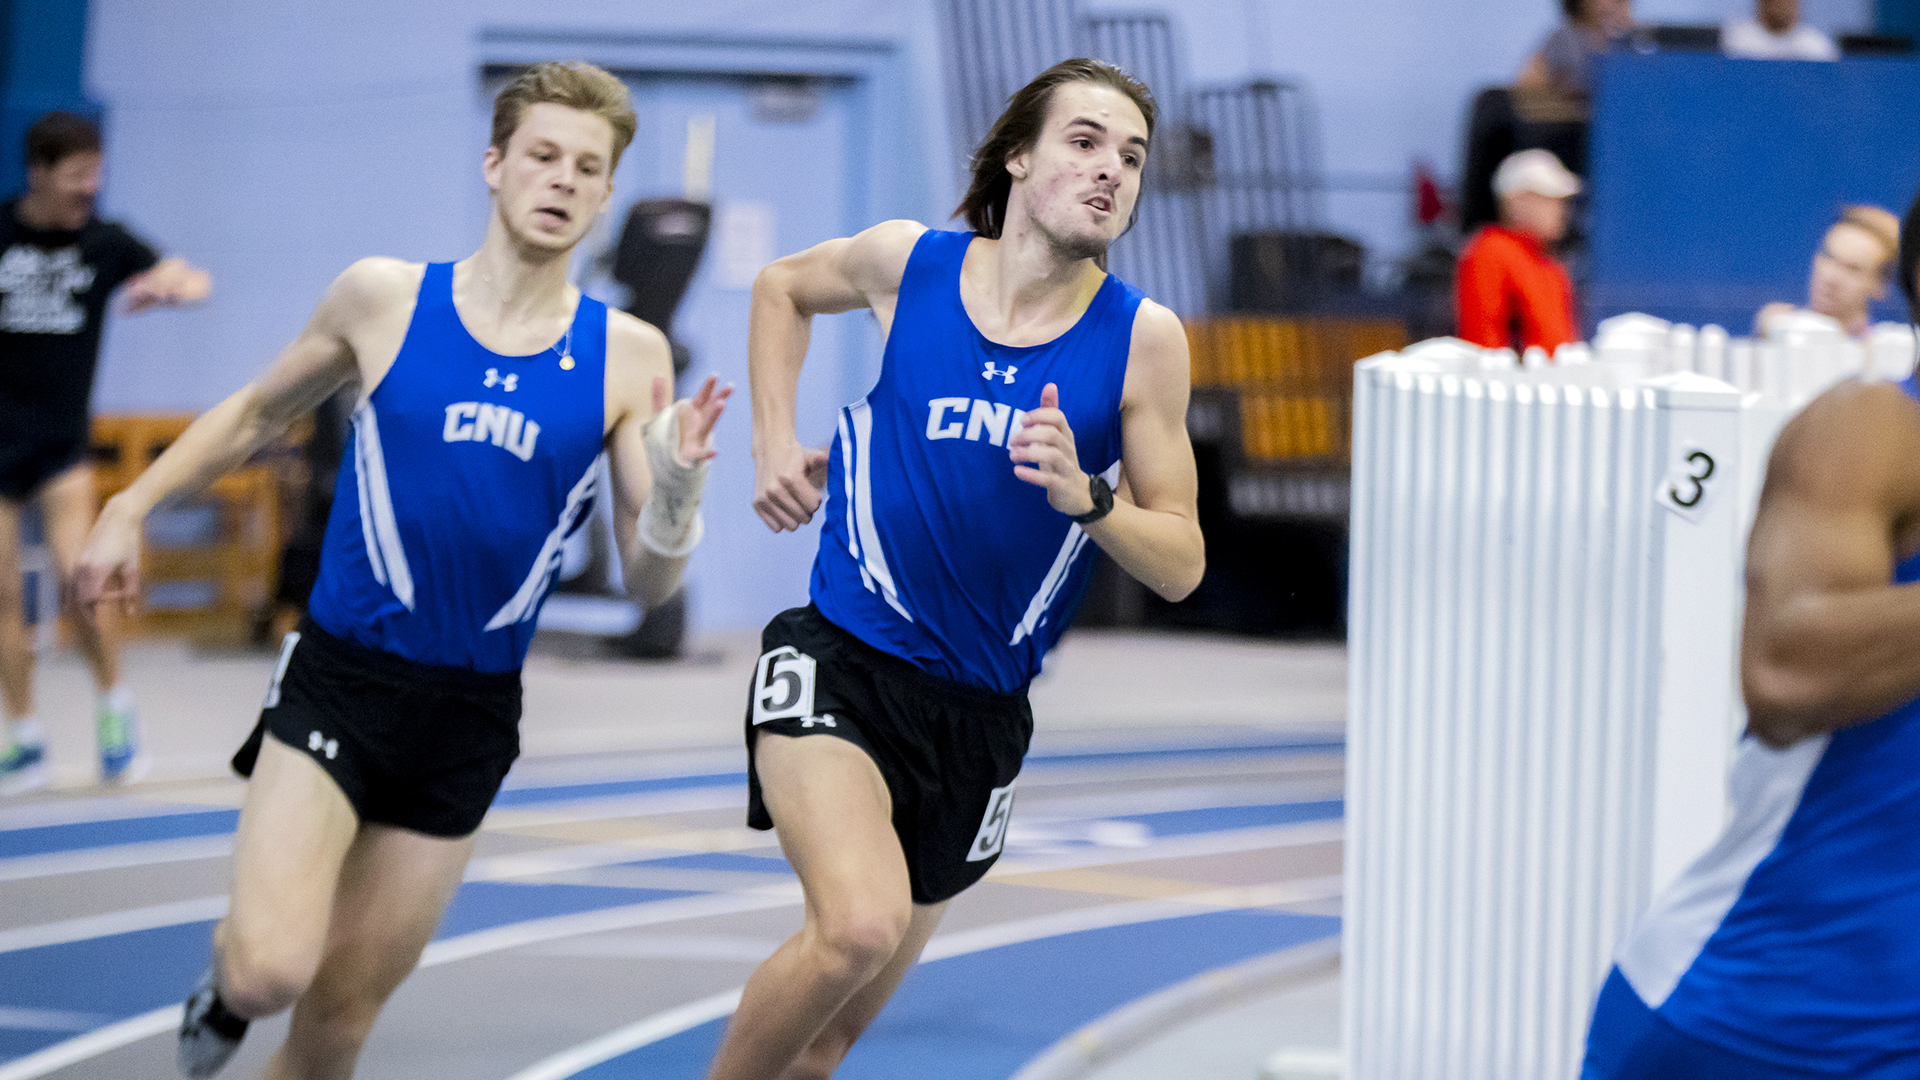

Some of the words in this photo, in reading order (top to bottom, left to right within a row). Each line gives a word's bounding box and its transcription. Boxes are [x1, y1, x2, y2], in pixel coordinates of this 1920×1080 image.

[443, 401, 541, 462] CNU
[1670, 451, 1715, 508] 3
[762, 651, 802, 713] 5
[979, 791, 1010, 852] 5
